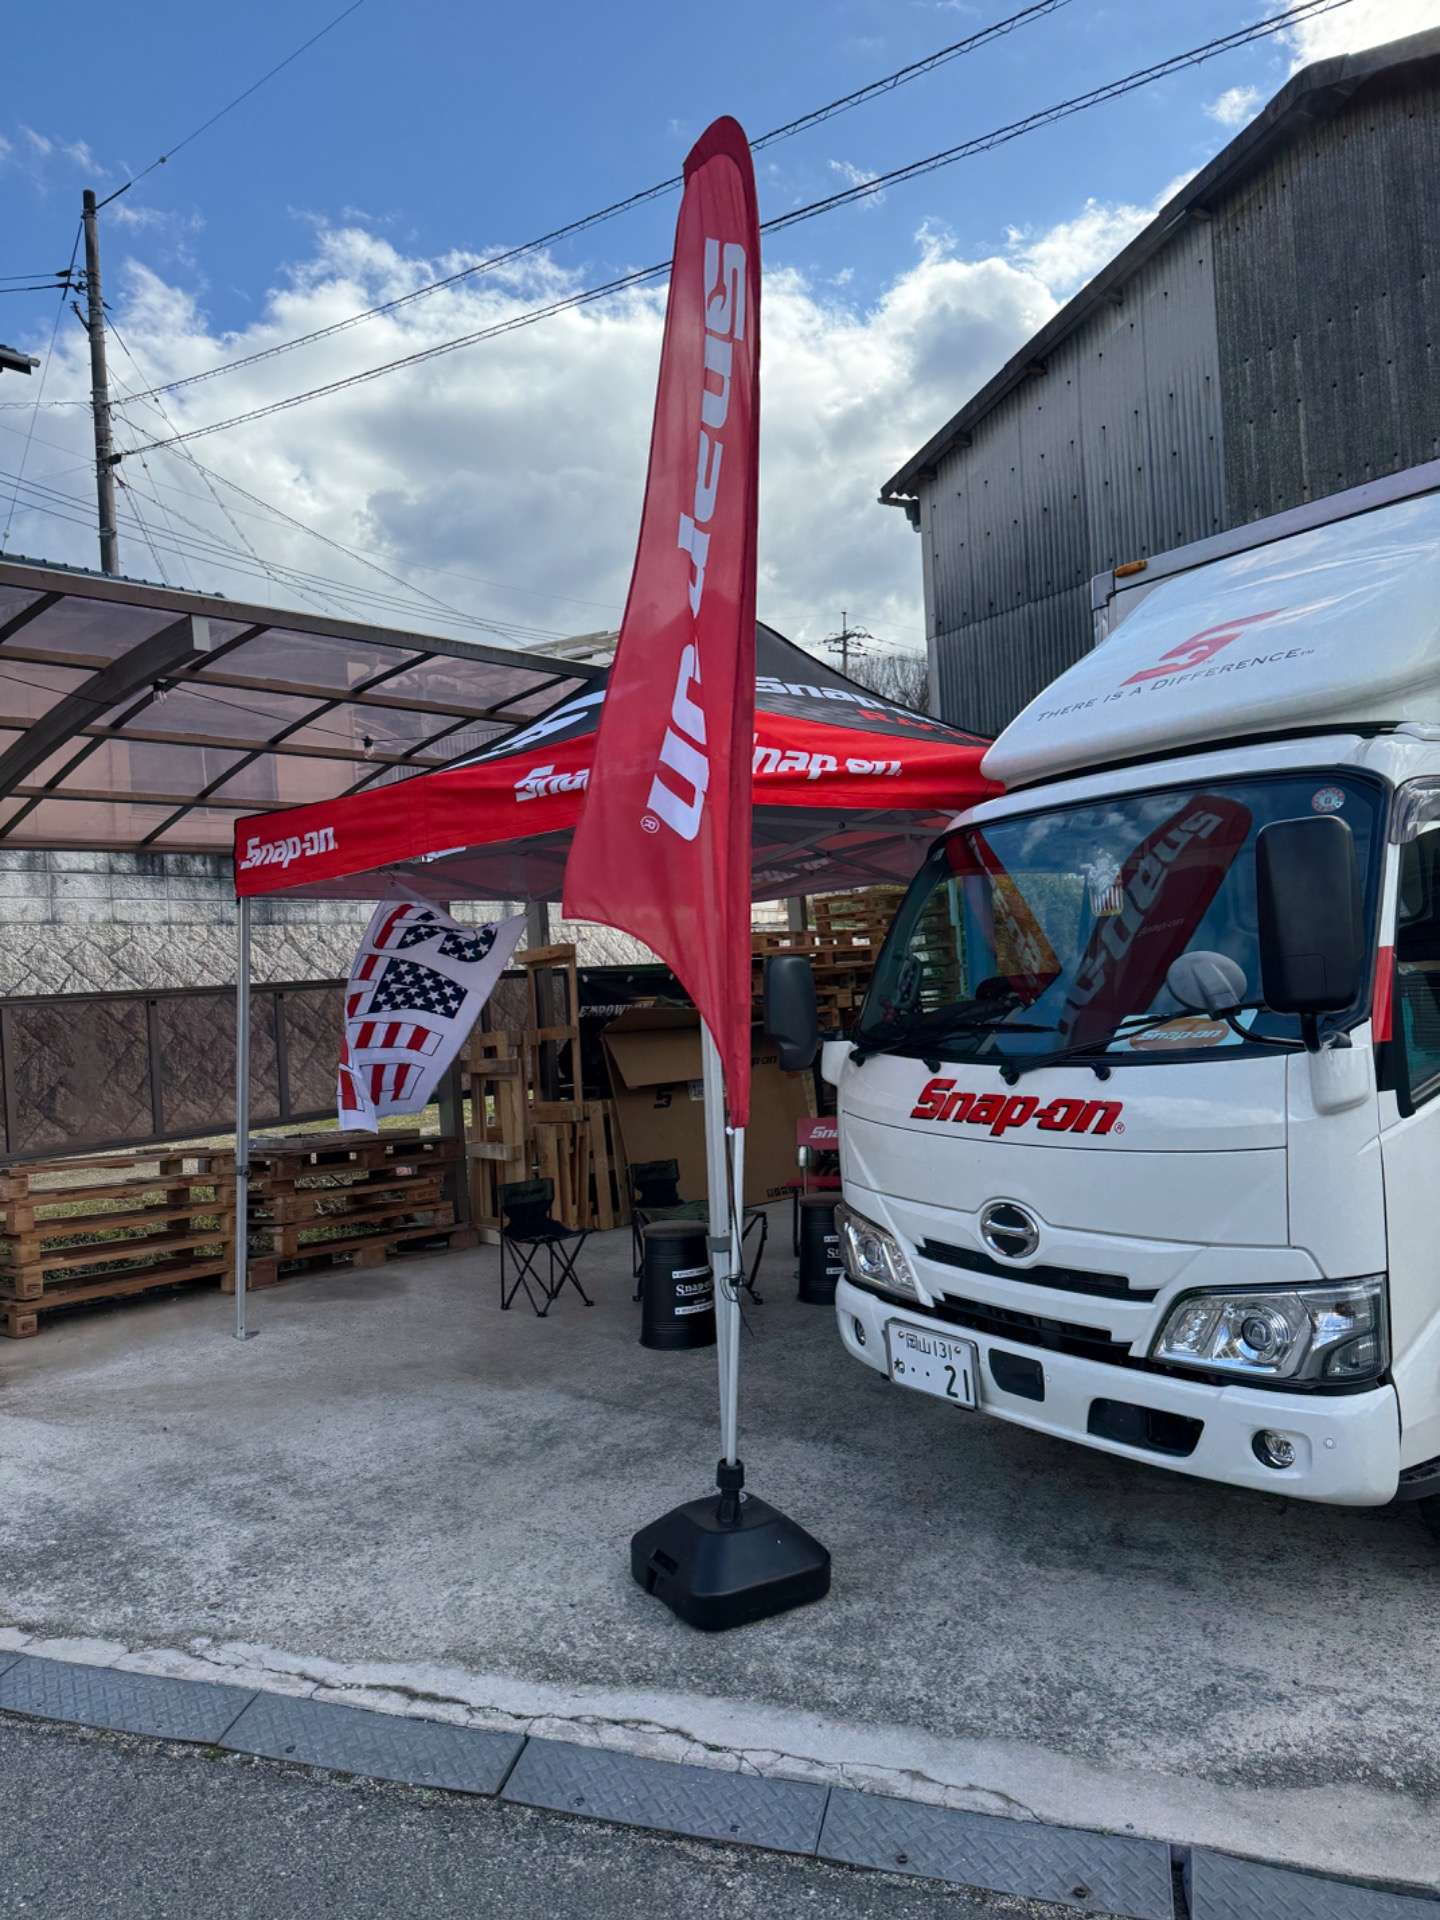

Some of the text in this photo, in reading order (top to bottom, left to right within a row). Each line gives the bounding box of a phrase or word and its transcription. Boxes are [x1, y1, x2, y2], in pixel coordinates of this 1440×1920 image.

[647, 236, 747, 842] Snapon
[1037, 647, 1302, 722] THERE IS A DIFFERENCE
[240, 826, 337, 870] Snap-on
[1136, 1029, 1222, 1041] Snap-on
[910, 1078, 1124, 1136] Snap-on
